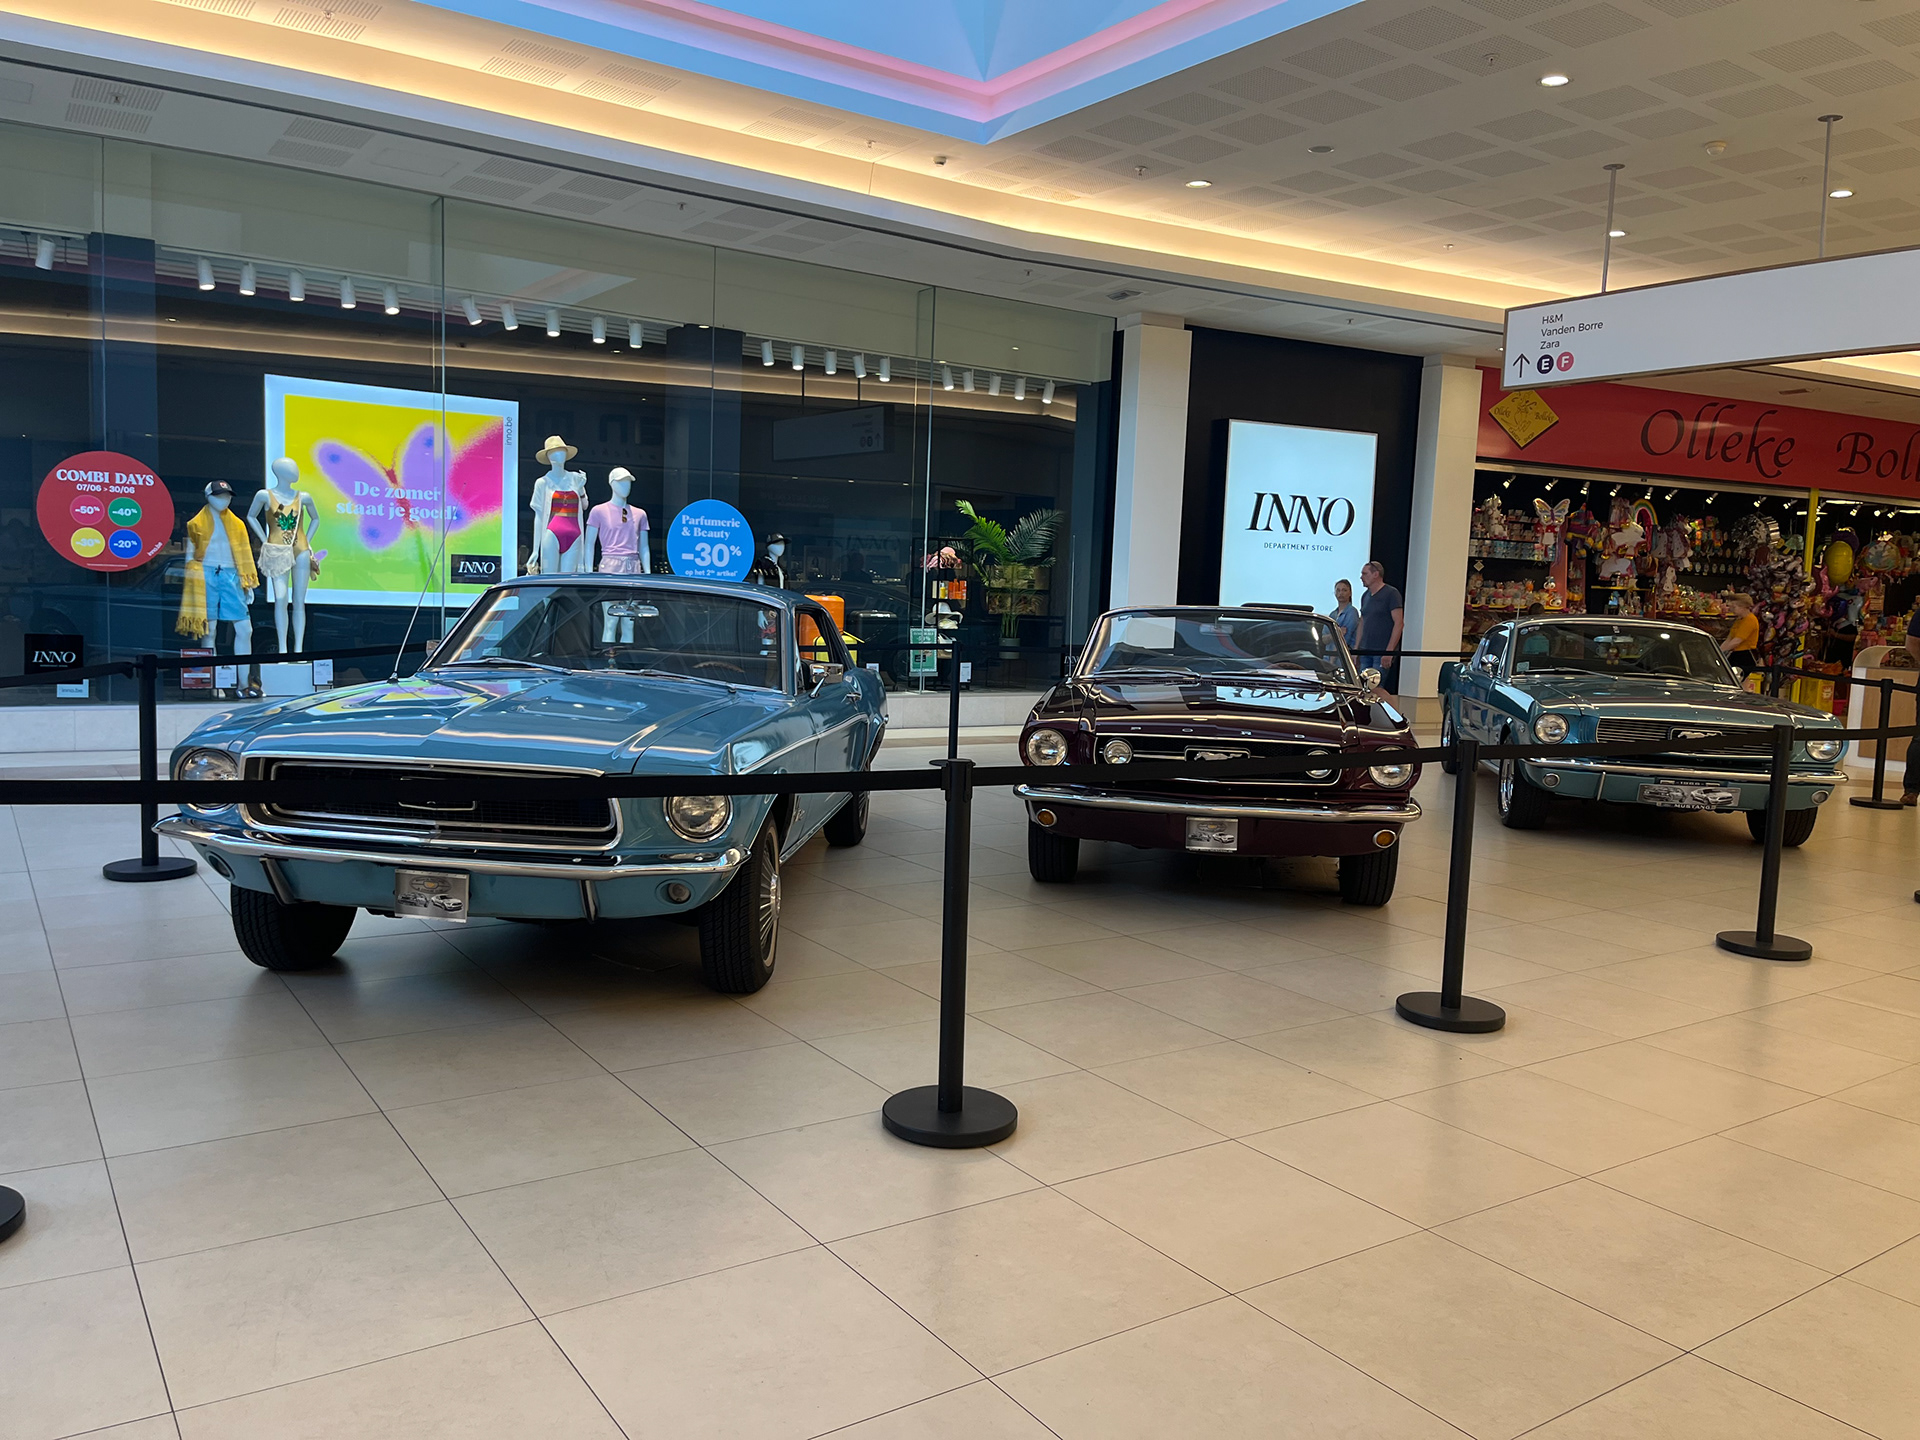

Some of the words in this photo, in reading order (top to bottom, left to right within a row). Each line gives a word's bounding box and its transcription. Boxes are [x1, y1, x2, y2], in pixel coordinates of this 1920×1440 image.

[1542, 314, 1563, 324] H&M
[1541, 325, 1575, 337] Vanden
[1578, 321, 1604, 332] Borre
[1540, 340, 1560, 350] Zara
[504, 416, 513, 446] inno.be
[1640, 402, 1796, 479] Olleke
[56, 469, 110, 484] COMBI
[115, 472, 155, 486] DAYS
[354, 480, 380, 497] De
[384, 486, 441, 501] zomer
[75, 506, 100, 515] -50%
[112, 508, 138, 517] -40%
[336, 501, 385, 516] staat
[389, 502, 406, 520] je
[409, 505, 458, 522] goed!
[1245, 492, 1355, 536] INNO
[681, 514, 741, 528] Parfumerie
[681, 526, 691, 537] &
[693, 527, 730, 540] Beauty
[113, 540, 138, 549] -20%
[1263, 542, 1310, 551] DEPARTMENT
[1311, 544, 1333, 552] STORE
[681, 542, 742, 567] -30%
[458, 561, 496, 574] INNO
[32, 650, 77, 663] INNO
